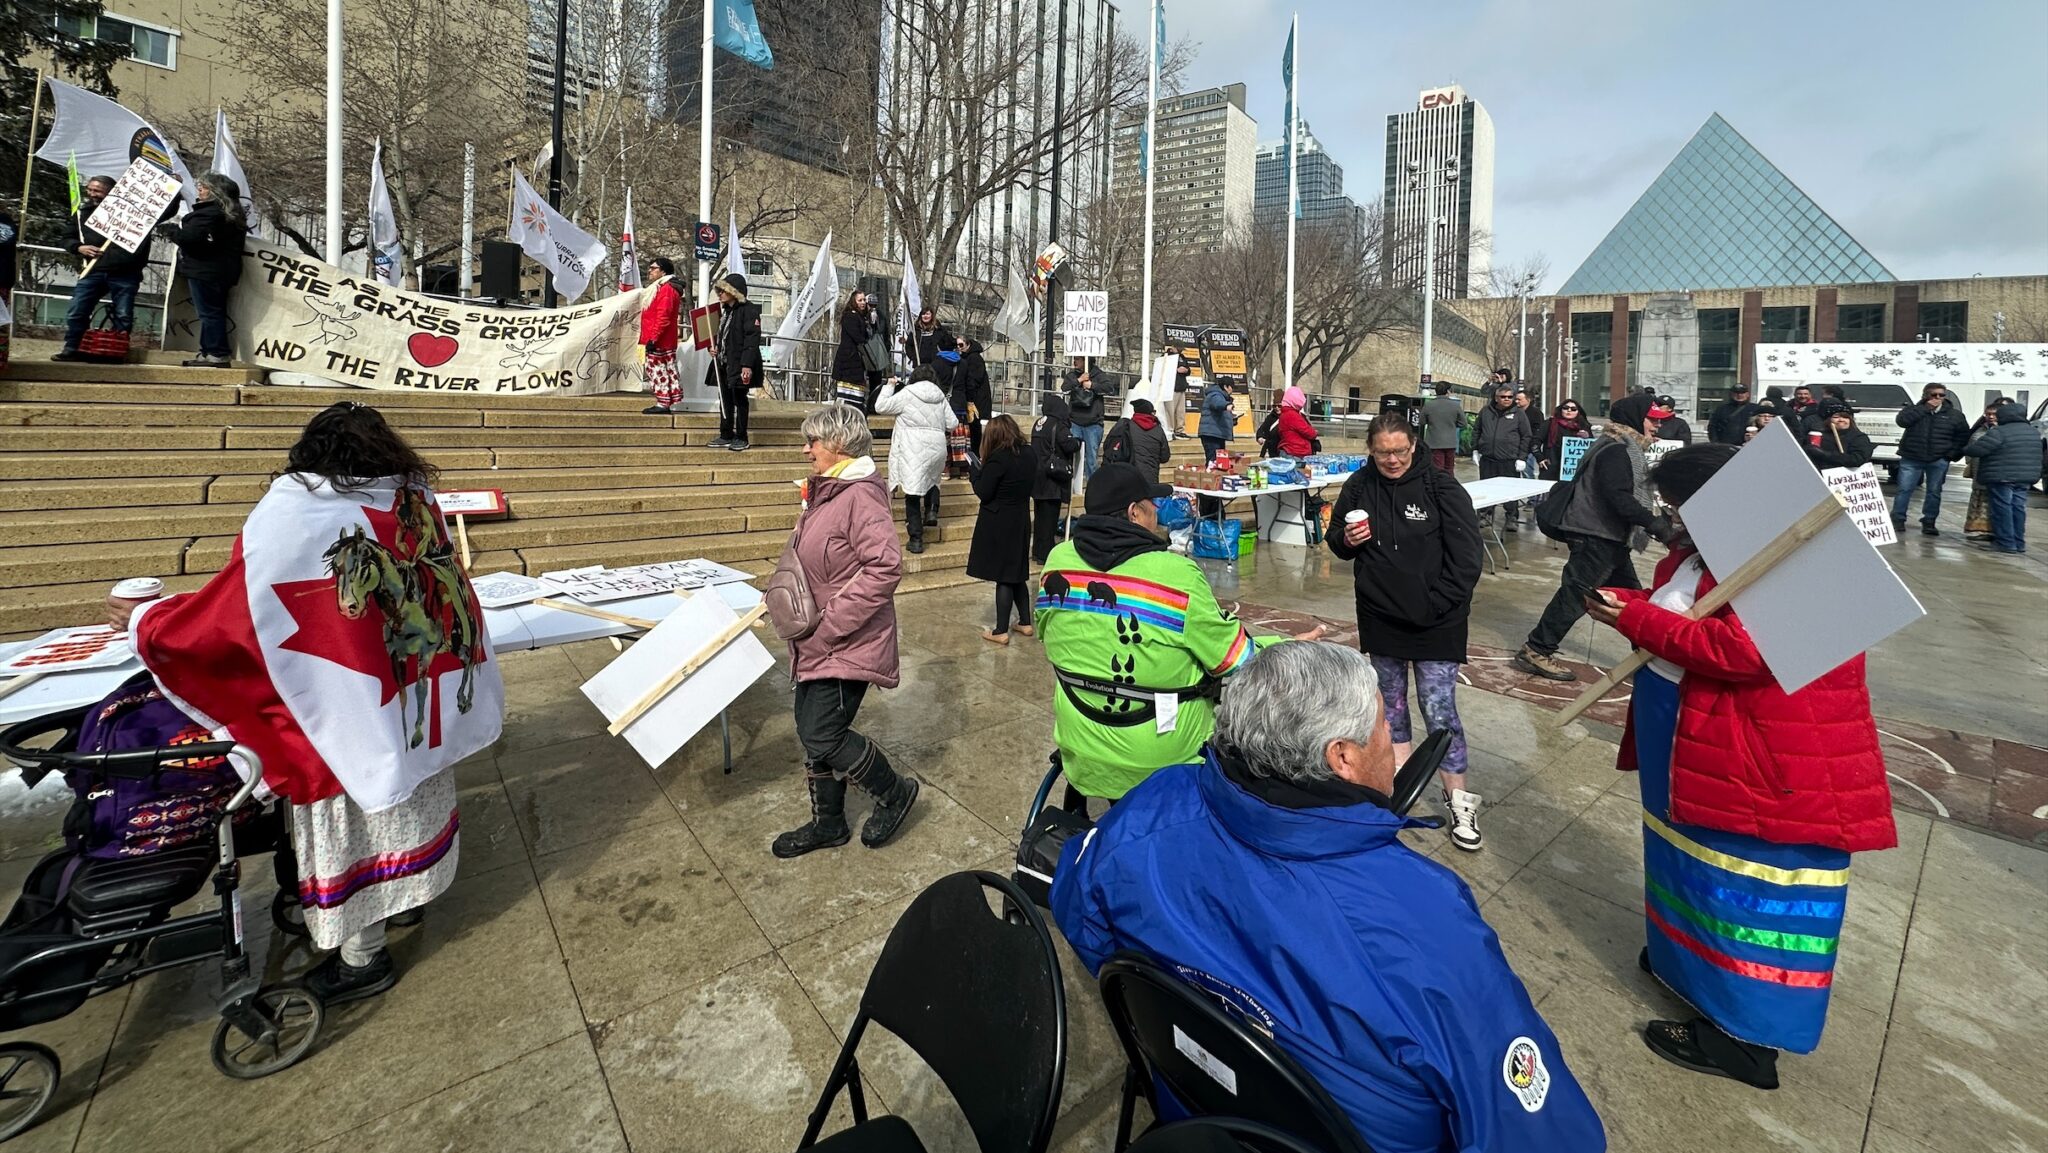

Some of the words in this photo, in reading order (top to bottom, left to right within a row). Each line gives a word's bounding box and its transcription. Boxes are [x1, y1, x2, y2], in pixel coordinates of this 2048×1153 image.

[1422, 90, 1454, 109] CN
[134, 160, 141, 169] As
[143, 164, 156, 180] Long
[159, 174, 168, 183] As
[137, 175, 149, 190] Sun
[150, 183, 172, 202] Shines
[100, 200, 115, 215] Such
[113, 199, 126, 210] And
[88, 215, 110, 234] Should
[263, 263, 332, 297] THE
[353, 295, 461, 336] GRASS
[479, 322, 570, 340] GROWS
[337, 277, 380, 297] AS
[396, 295, 450, 317] THE
[465, 306, 603, 326] SUNSHINES
[1066, 293, 1106, 312] LAND
[1166, 328, 1194, 338] DEFEND
[1212, 333, 1239, 341] DEFEND
[254, 338, 306, 361] AND
[326, 350, 380, 379] THE
[394, 367, 480, 391] RIVER
[496, 370, 573, 391] FLOWS
[1828, 474, 1859, 487] TREATY
[1861, 470, 1875, 479] THE
[1844, 480, 1877, 492] HONOUR
[1859, 491, 1877, 502] THE
[1869, 516, 1885, 525] THE
[1863, 525, 1892, 541] HON
[546, 572, 600, 585] WE
[575, 577, 646, 590] THE
[572, 589, 599, 598] IN
[1085, 681, 1114, 693] Evolution
